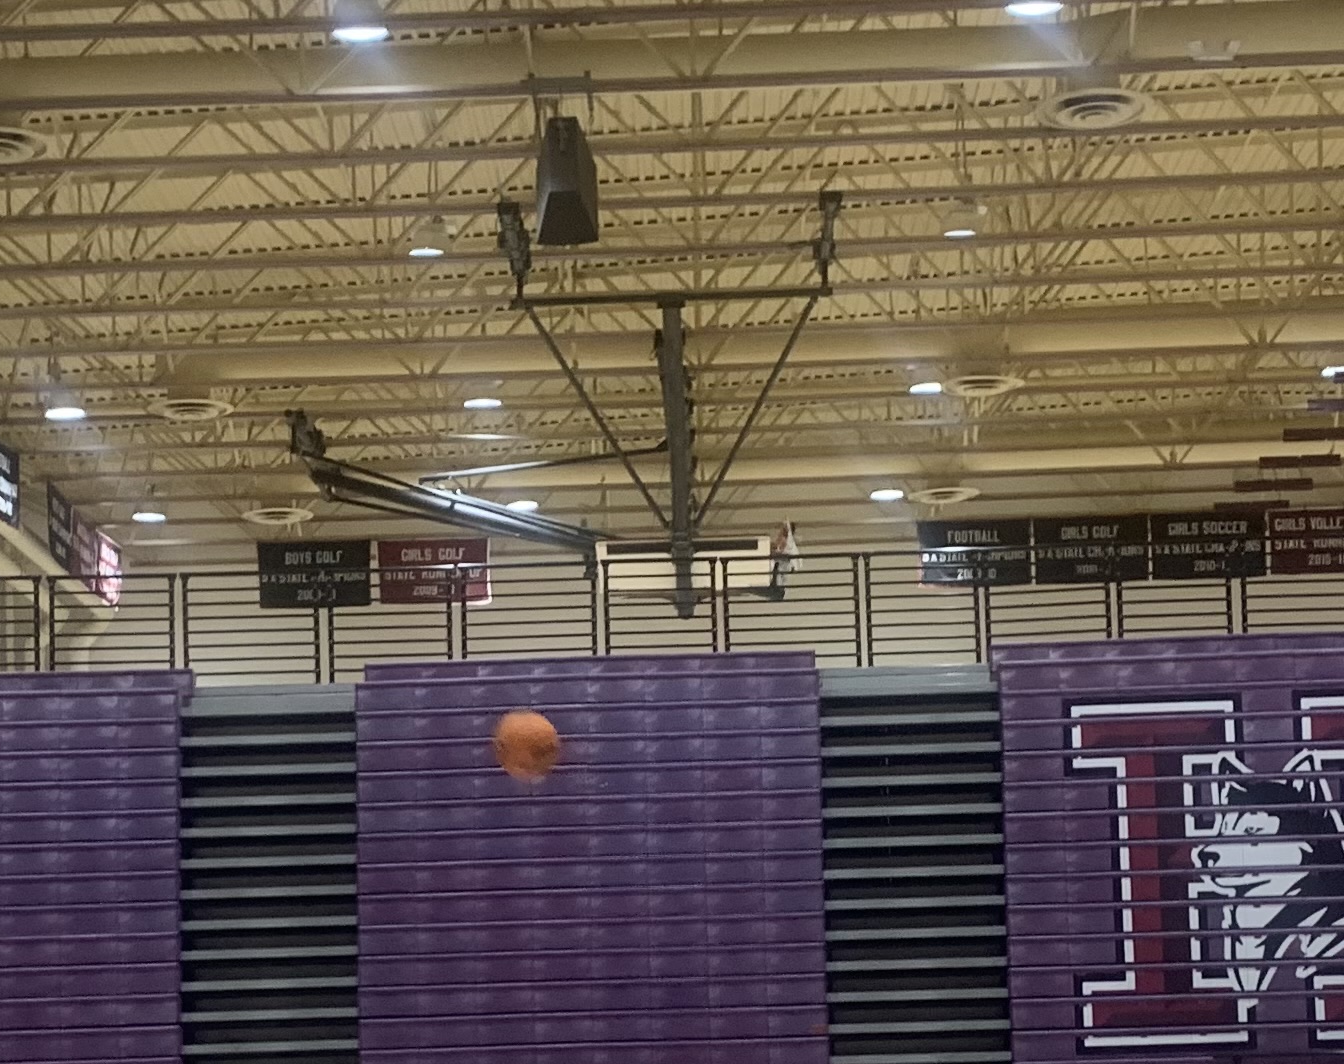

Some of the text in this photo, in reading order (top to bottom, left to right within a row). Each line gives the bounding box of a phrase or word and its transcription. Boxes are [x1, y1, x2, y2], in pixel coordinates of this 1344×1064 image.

[1203, 520, 1248, 535] SOCCER
[284, 551, 313, 565] BOYS
[401, 548, 433, 562] GIRLS
